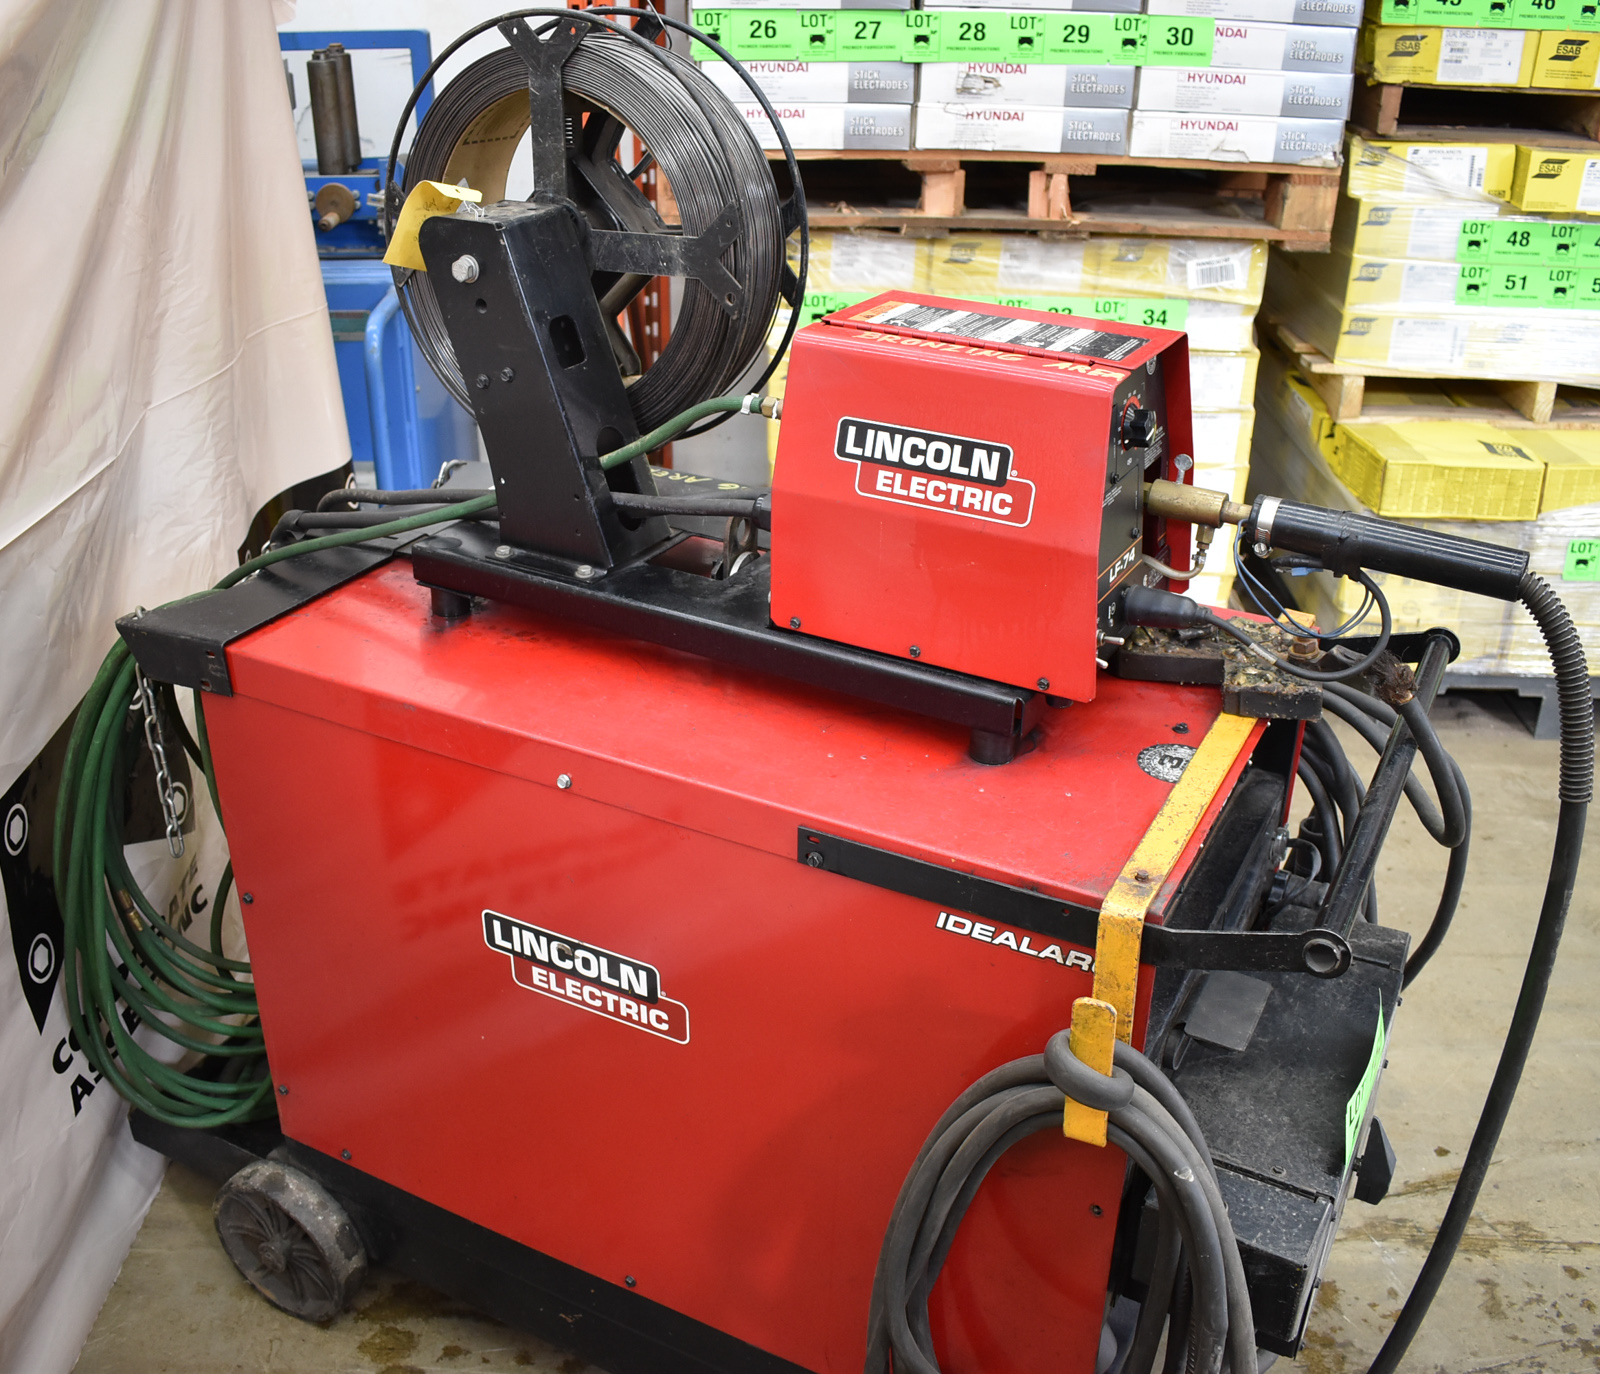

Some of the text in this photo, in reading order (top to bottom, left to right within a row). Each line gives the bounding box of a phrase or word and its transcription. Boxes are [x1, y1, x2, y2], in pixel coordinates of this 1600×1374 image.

[1301, 2, 1355, 14] ELECTRODES
[696, 13, 777, 39] LOT 26
[801, 14, 882, 40] LOT 27
[906, 14, 986, 41] LOT 28
[1010, 16, 1090, 44] LOT 29
[1115, 18, 1194, 46] LOT 30
[1215, 27, 1247, 38] NDAI
[1292, 41, 1316, 50] STICK
[1394, 41, 1421, 51] ESAB
[1556, 45, 1581, 55] ESAB
[1289, 51, 1343, 63] ELECTRODES
[750, 62, 809, 73] HYUNDAI
[968, 63, 1027, 74] HYUNDAI
[854, 70, 880, 79] STICK
[1071, 73, 1098, 83] STICK
[1187, 72, 1246, 85] HYUNDAI
[854, 80, 908, 90] ELECTRODES
[1071, 84, 1126, 94] ELECTRODES
[1290, 85, 1315, 95] STICK
[1288, 96, 1343, 107] ELECTRODES
[850, 116, 875, 126] STICK
[965, 111, 1024, 121] HYUNDAI
[850, 126, 904, 136] ELECTRODES
[1068, 121, 1094, 131] STICK
[1180, 120, 1239, 132] HYUNDAI
[1067, 131, 1121, 142] ELECTRODES
[1539, 164, 1562, 173] ESAB
[1462, 223, 1531, 247] LOT 48
[1551, 226, 1575, 238] LOT
[1461, 267, 1527, 290] LOT 51
[1549, 270, 1573, 282] LOT
[803, 295, 828, 307] LOT
[1095, 302, 1167, 326] LOT 34
[852, 331, 1126, 382] BRONZING AREA
[845, 425, 1000, 481] LINCOLN
[876, 470, 1013, 515] ELECTRIC
[1571, 542, 1593, 554] LOT
[1109, 547, 1136, 583] LF-74
[936, 911, 1096, 974] IDEALAR
[493, 919, 648, 997] LINCOLN
[532, 965, 669, 1031] ELECTRIC
